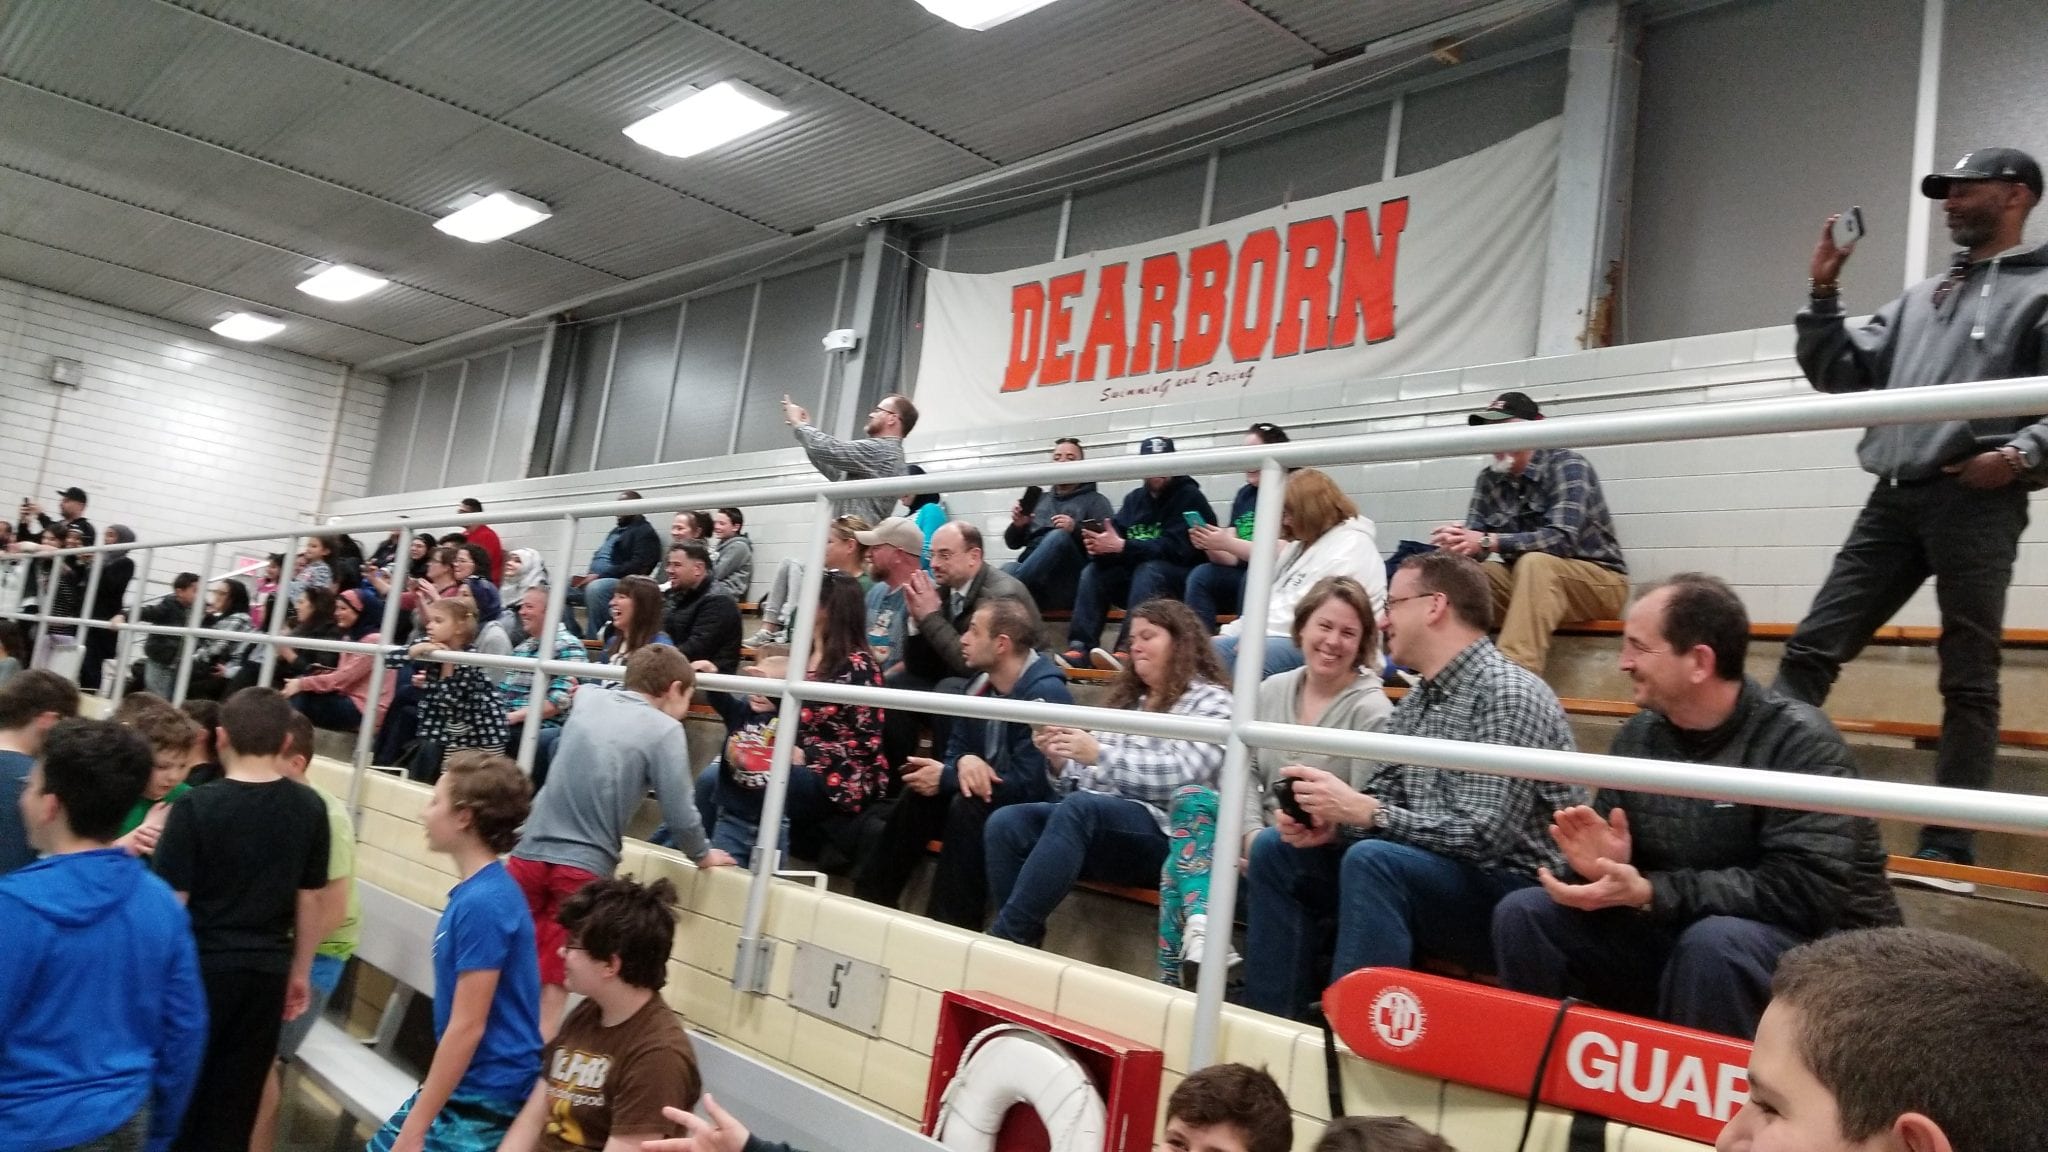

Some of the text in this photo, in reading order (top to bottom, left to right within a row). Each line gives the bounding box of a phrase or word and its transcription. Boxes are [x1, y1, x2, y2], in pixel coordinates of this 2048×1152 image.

[1001, 196, 1410, 393] DEARBORN
[1100, 366, 1256, 402] Swimming and Diving
